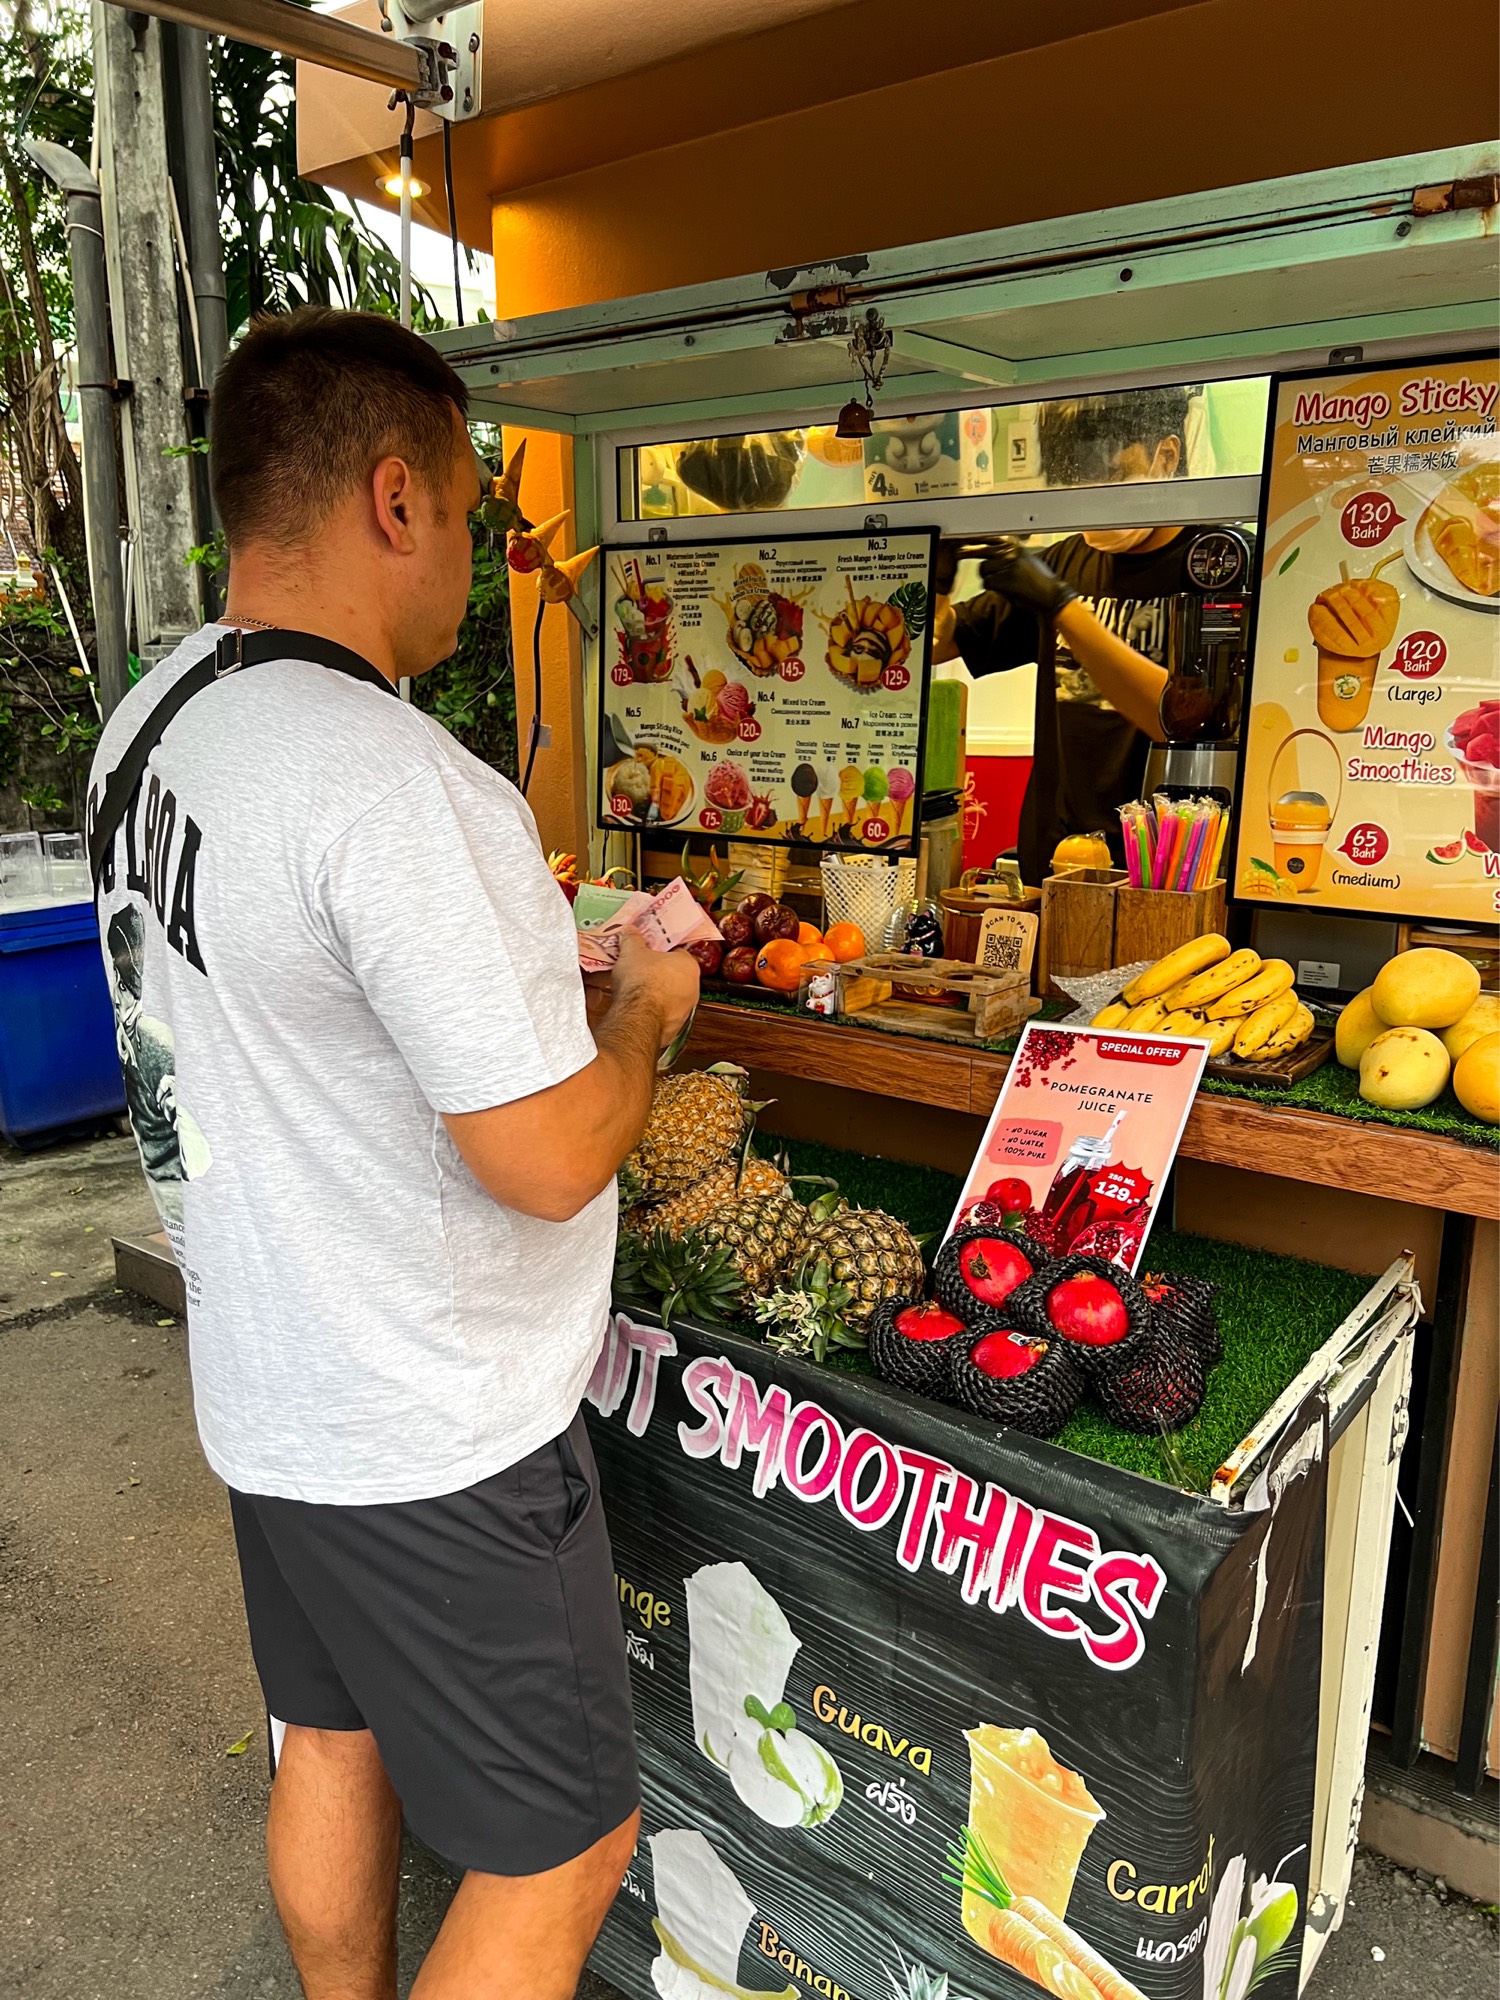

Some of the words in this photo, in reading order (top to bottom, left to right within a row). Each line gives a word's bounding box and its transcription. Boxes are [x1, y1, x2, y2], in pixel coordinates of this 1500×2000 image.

[1293, 391, 1389, 427] Mango
[1400, 378, 1498, 415] Sticky
[1297, 425, 1399, 454] Манговый
[1405, 416, 1496, 445] клейкий
[1367, 450, 1458, 474] 芒果糯米饭
[872, 472, 887, 497] 4
[1345, 502, 1391, 525] 130
[1351, 525, 1382, 540] Baht
[868, 538, 887, 551] No.3
[645, 554, 661, 565] No.1
[759, 548, 777, 560] No.2
[837, 555, 852, 563] Fresh
[853, 554, 871, 563] Mango
[877, 553, 896, 562] Mango
[897, 552, 905, 560] Ice
[906, 552, 924, 560] Cream
[754, 586, 770, 594] Cream
[1398, 640, 1441, 660] 120
[1403, 660, 1432, 673] Baht
[757, 691, 775, 702] No.4
[1387, 685, 1442, 705] (Large)
[782, 698, 799, 706] Mixed
[808, 699, 826, 707] Cream
[625, 707, 642, 718] No.5
[869, 711, 878, 719] Ice
[878, 711, 897, 719] Cream
[640, 723, 655, 731] Mango
[656, 723, 672, 734] Sticky
[672, 726, 683, 736] Rice
[841, 718, 860, 729] No.7
[1362, 725, 1433, 754] Mango
[700, 751, 717, 762] No.6
[726, 748, 742, 757] Choice
[743, 749, 749, 757] of
[762, 750, 770, 758] Ice
[770, 750, 786, 759] Cream
[1346, 757, 1454, 783] Smoothies
[1352, 829, 1378, 848] 65
[1351, 847, 1377, 859] Baht
[1331, 869, 1401, 890] (medium)
[985, 916, 1004, 929] SCAN
[1006, 915, 1015, 923] TO
[1016, 921, 1027, 934] PAY
[1100, 1041, 1144, 1056] SPECIAL
[1146, 1046, 1181, 1059] OFFER
[1050, 1082, 1154, 1104] POMEGRANATE
[1077, 1100, 1117, 1114] JUICE
[1024, 1128, 1048, 1139] SUGAR
[1007, 1136, 1019, 1145] NO
[1019, 1138, 1044, 1148] WATER
[1004, 1146, 1026, 1157] 100%
[1027, 1150, 1047, 1160] PURE
[1124, 1177, 1136, 1187] ML
[678, 1356, 1168, 1672] SMOOTHIES
[614, 1573, 671, 1630] nge
[812, 1684, 933, 1777] Guava
[865, 1776, 917, 1825] ฝรั่ง
[1106, 1833, 1216, 1915] Carrot
